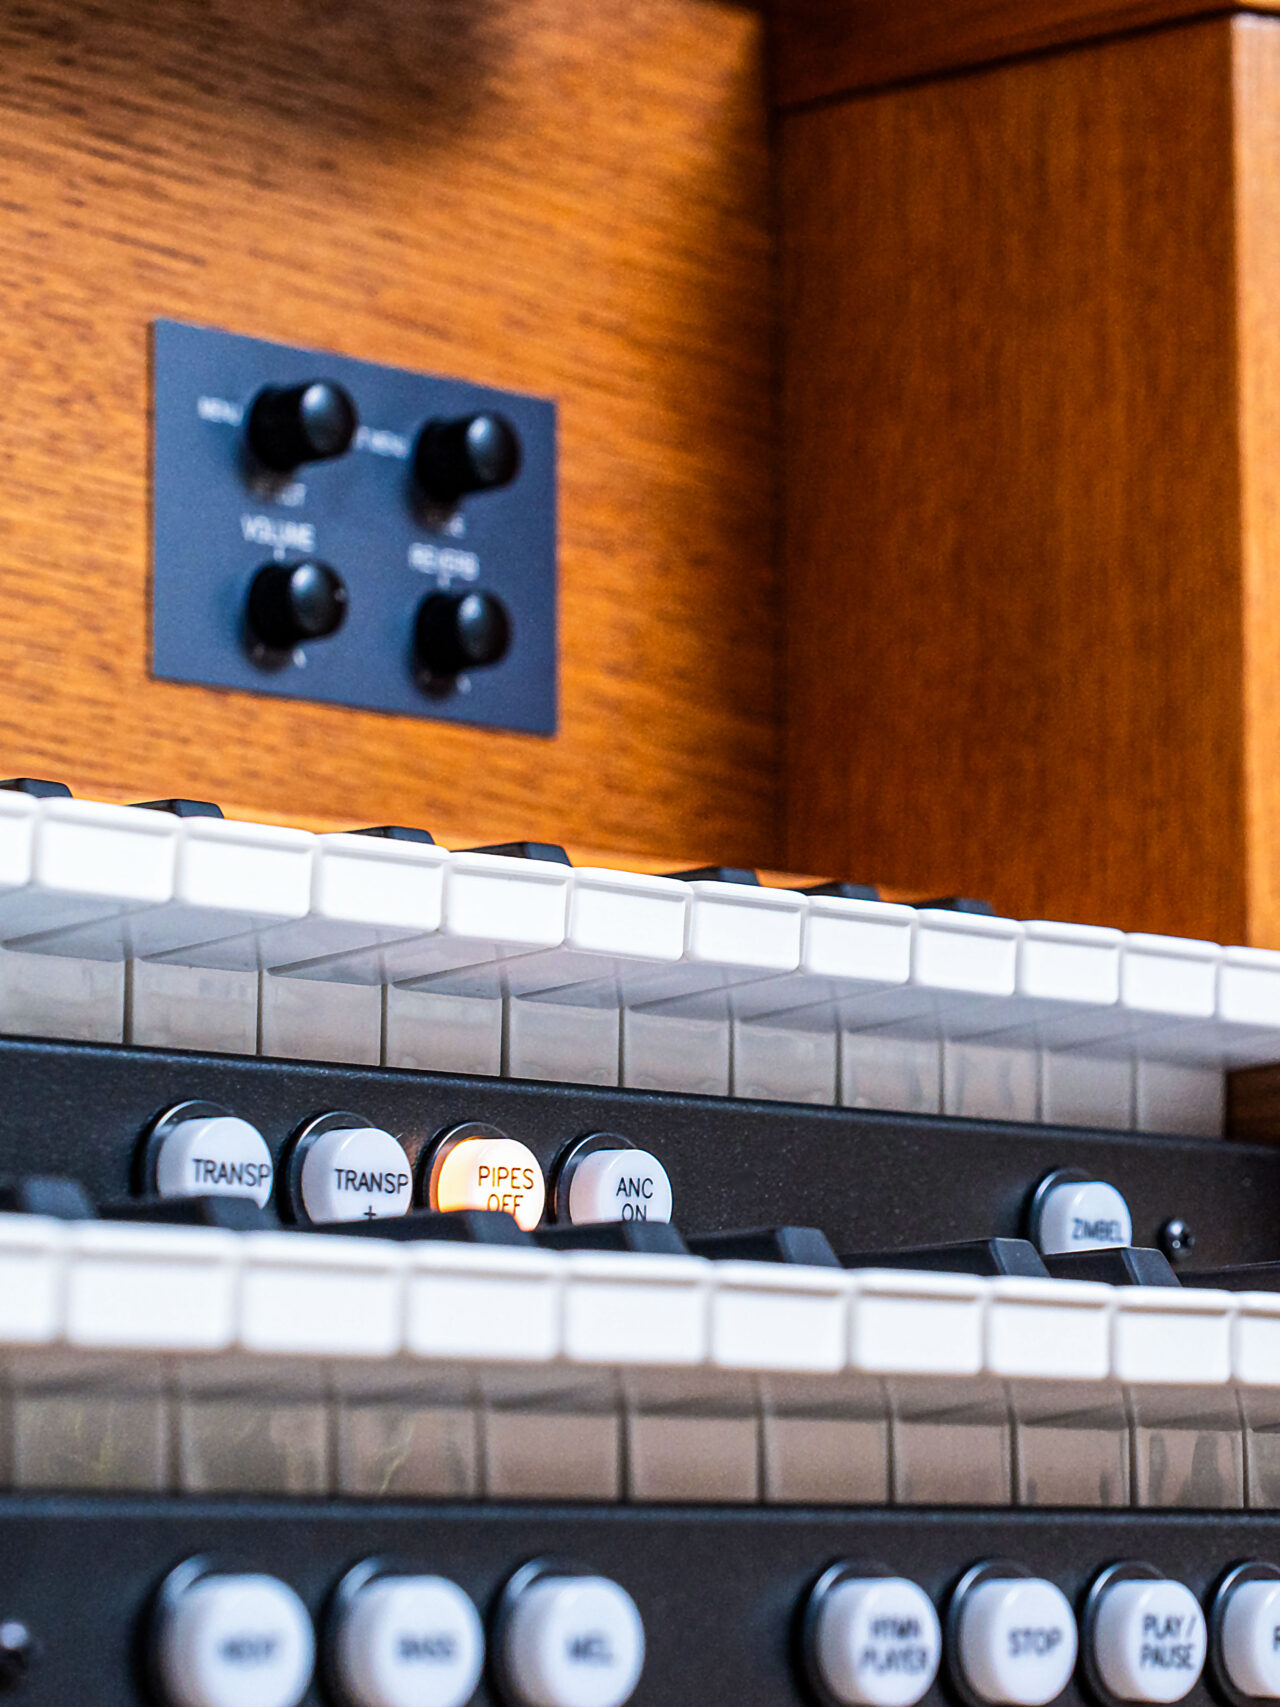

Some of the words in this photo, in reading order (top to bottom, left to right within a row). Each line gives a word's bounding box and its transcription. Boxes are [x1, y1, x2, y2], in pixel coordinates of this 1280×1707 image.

[193, 1158, 272, 1187] TRANSP
[335, 1168, 409, 1194] TRANSP
[478, 1165, 535, 1190] PIPES
[616, 1176, 655, 1199] ANC
[487, 1193, 524, 1216] OFF
[621, 1202, 648, 1222] ON
[1072, 1218, 1124, 1242] ZIMBEL
[1009, 1626, 1063, 1656] STOP
[862, 1646, 929, 1675] PLAYER
[1142, 1643, 1194, 1671] PAUSE
